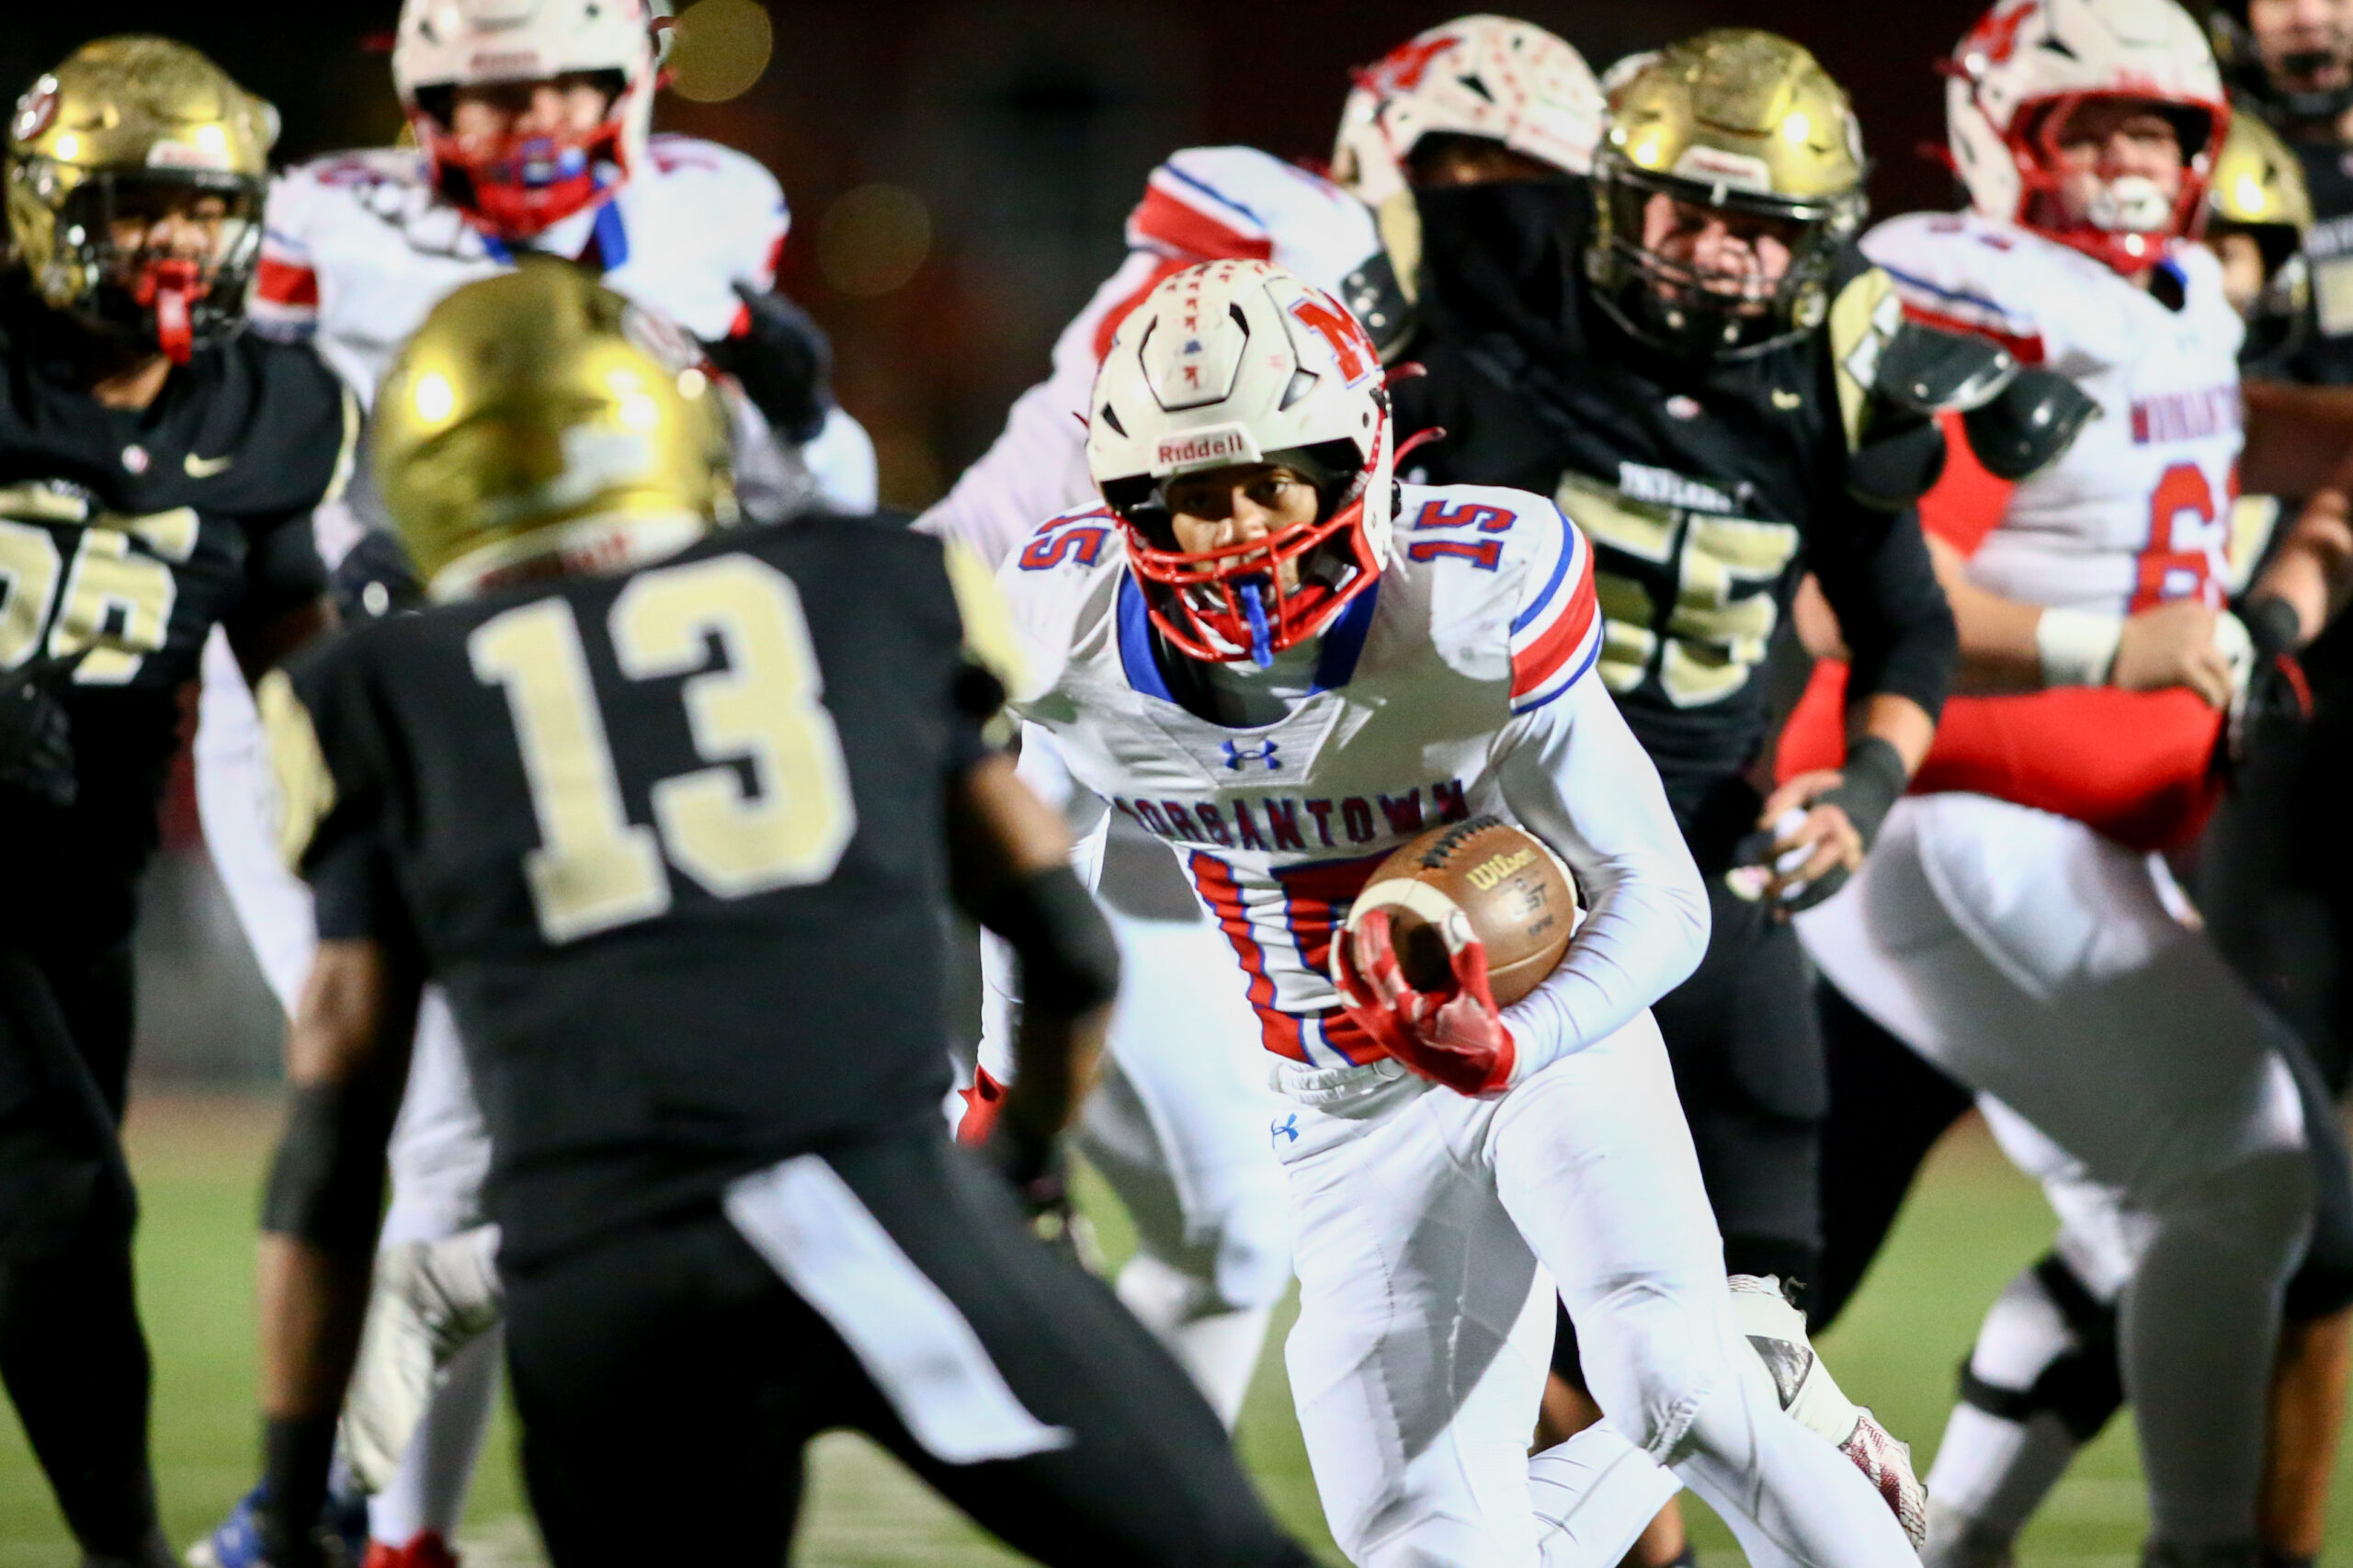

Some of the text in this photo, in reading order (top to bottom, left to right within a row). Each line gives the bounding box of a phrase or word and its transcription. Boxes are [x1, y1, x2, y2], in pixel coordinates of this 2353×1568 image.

[1287, 287, 1383, 390] M
[1158, 433, 1244, 463] Riddell
[1407, 499, 1518, 573] 15
[1555, 471, 1799, 710] 55
[466, 551, 858, 945] 13
[1465, 847, 1538, 892] Wilson
